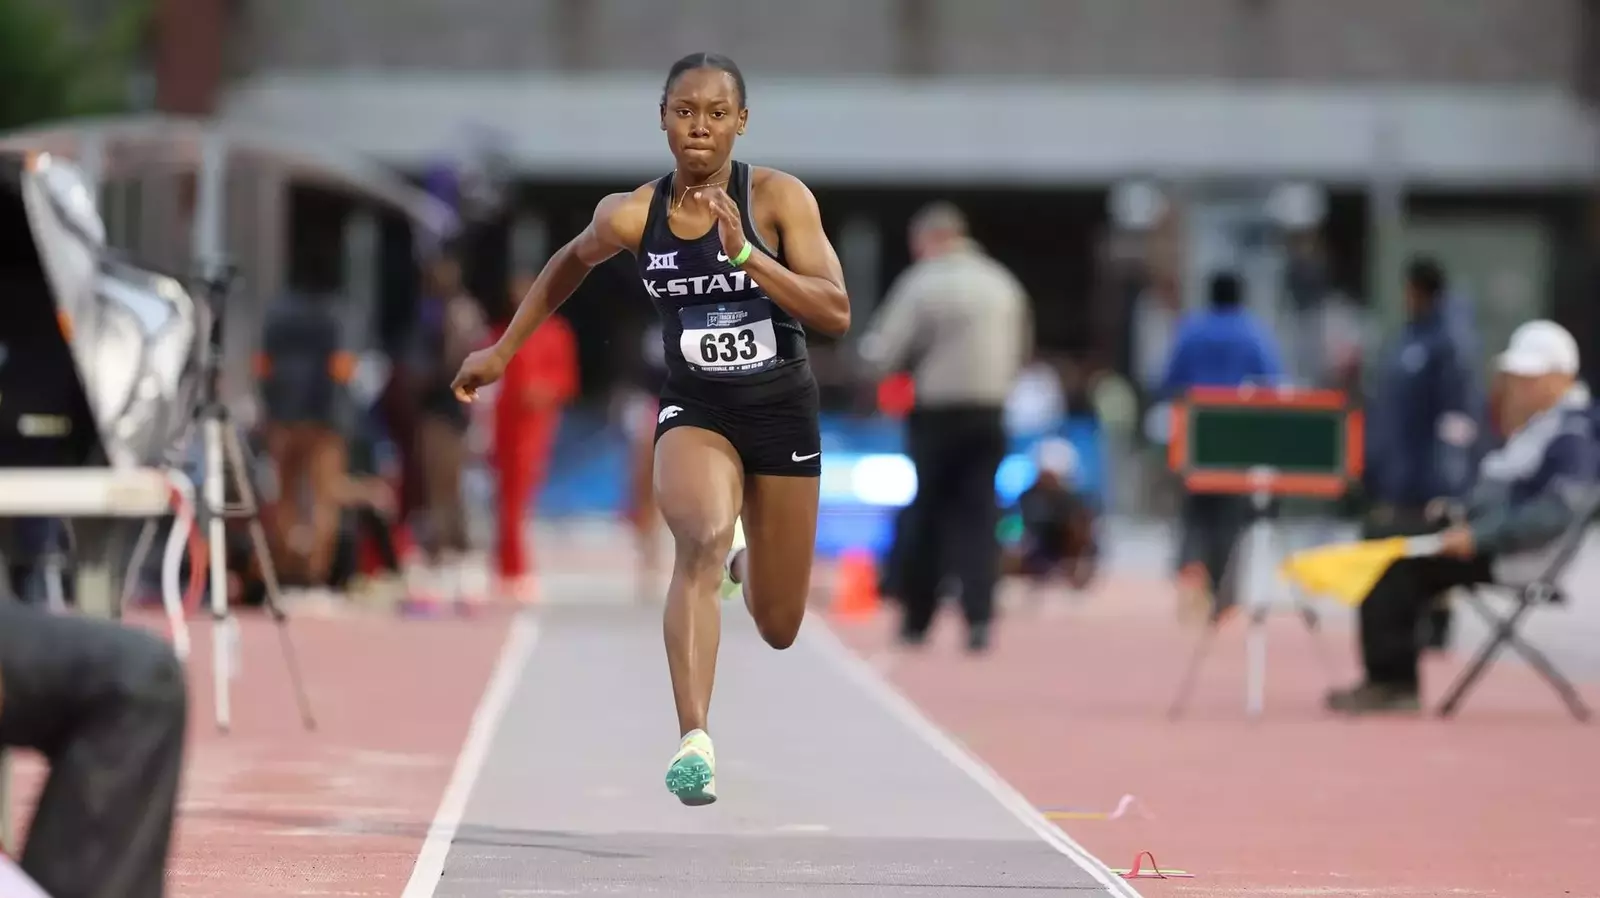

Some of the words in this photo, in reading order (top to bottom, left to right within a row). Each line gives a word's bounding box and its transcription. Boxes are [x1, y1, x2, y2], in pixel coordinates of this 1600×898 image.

[646, 251, 679, 270] XII
[642, 270, 759, 298] K-STAT
[700, 329, 757, 362] 633
